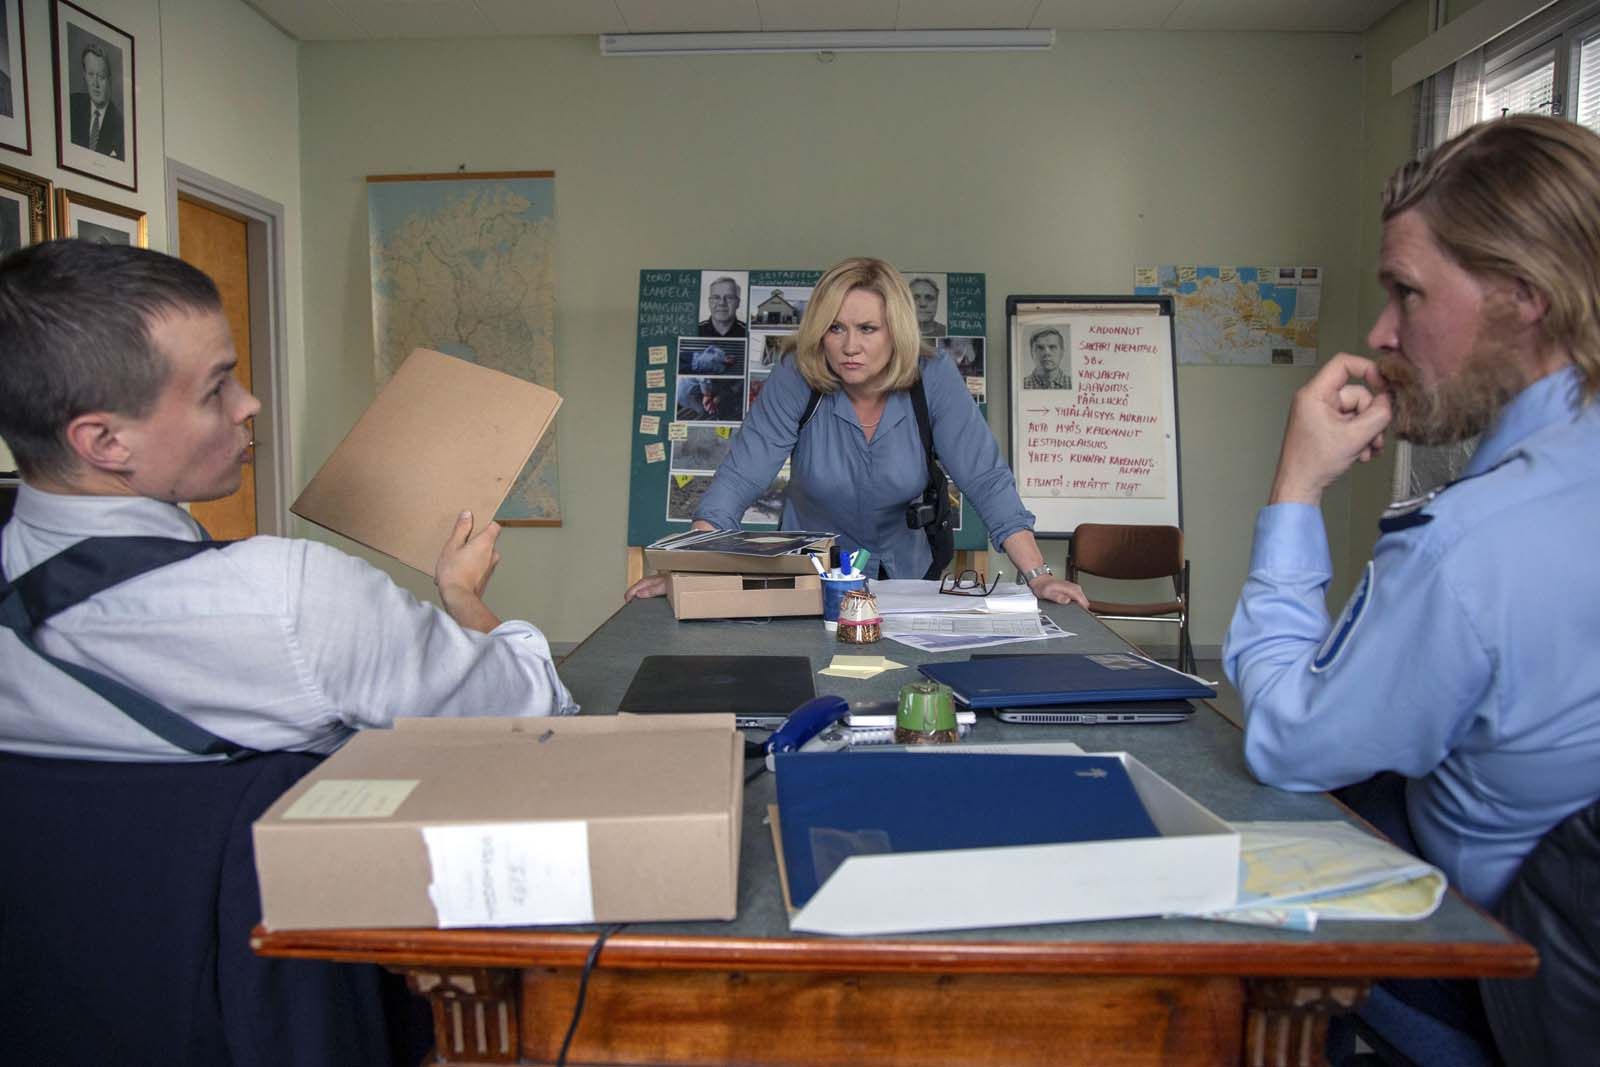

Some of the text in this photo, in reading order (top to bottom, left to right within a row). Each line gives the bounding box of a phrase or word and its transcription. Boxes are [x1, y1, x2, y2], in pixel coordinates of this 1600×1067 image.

[1088, 325, 1144, 336] KADONNUT
[1055, 421, 1082, 434] MYÖS
[1085, 424, 1143, 437] KADONNUT
[1027, 451, 1063, 464] YHTEYS
[1070, 453, 1107, 465] KUNNAN
